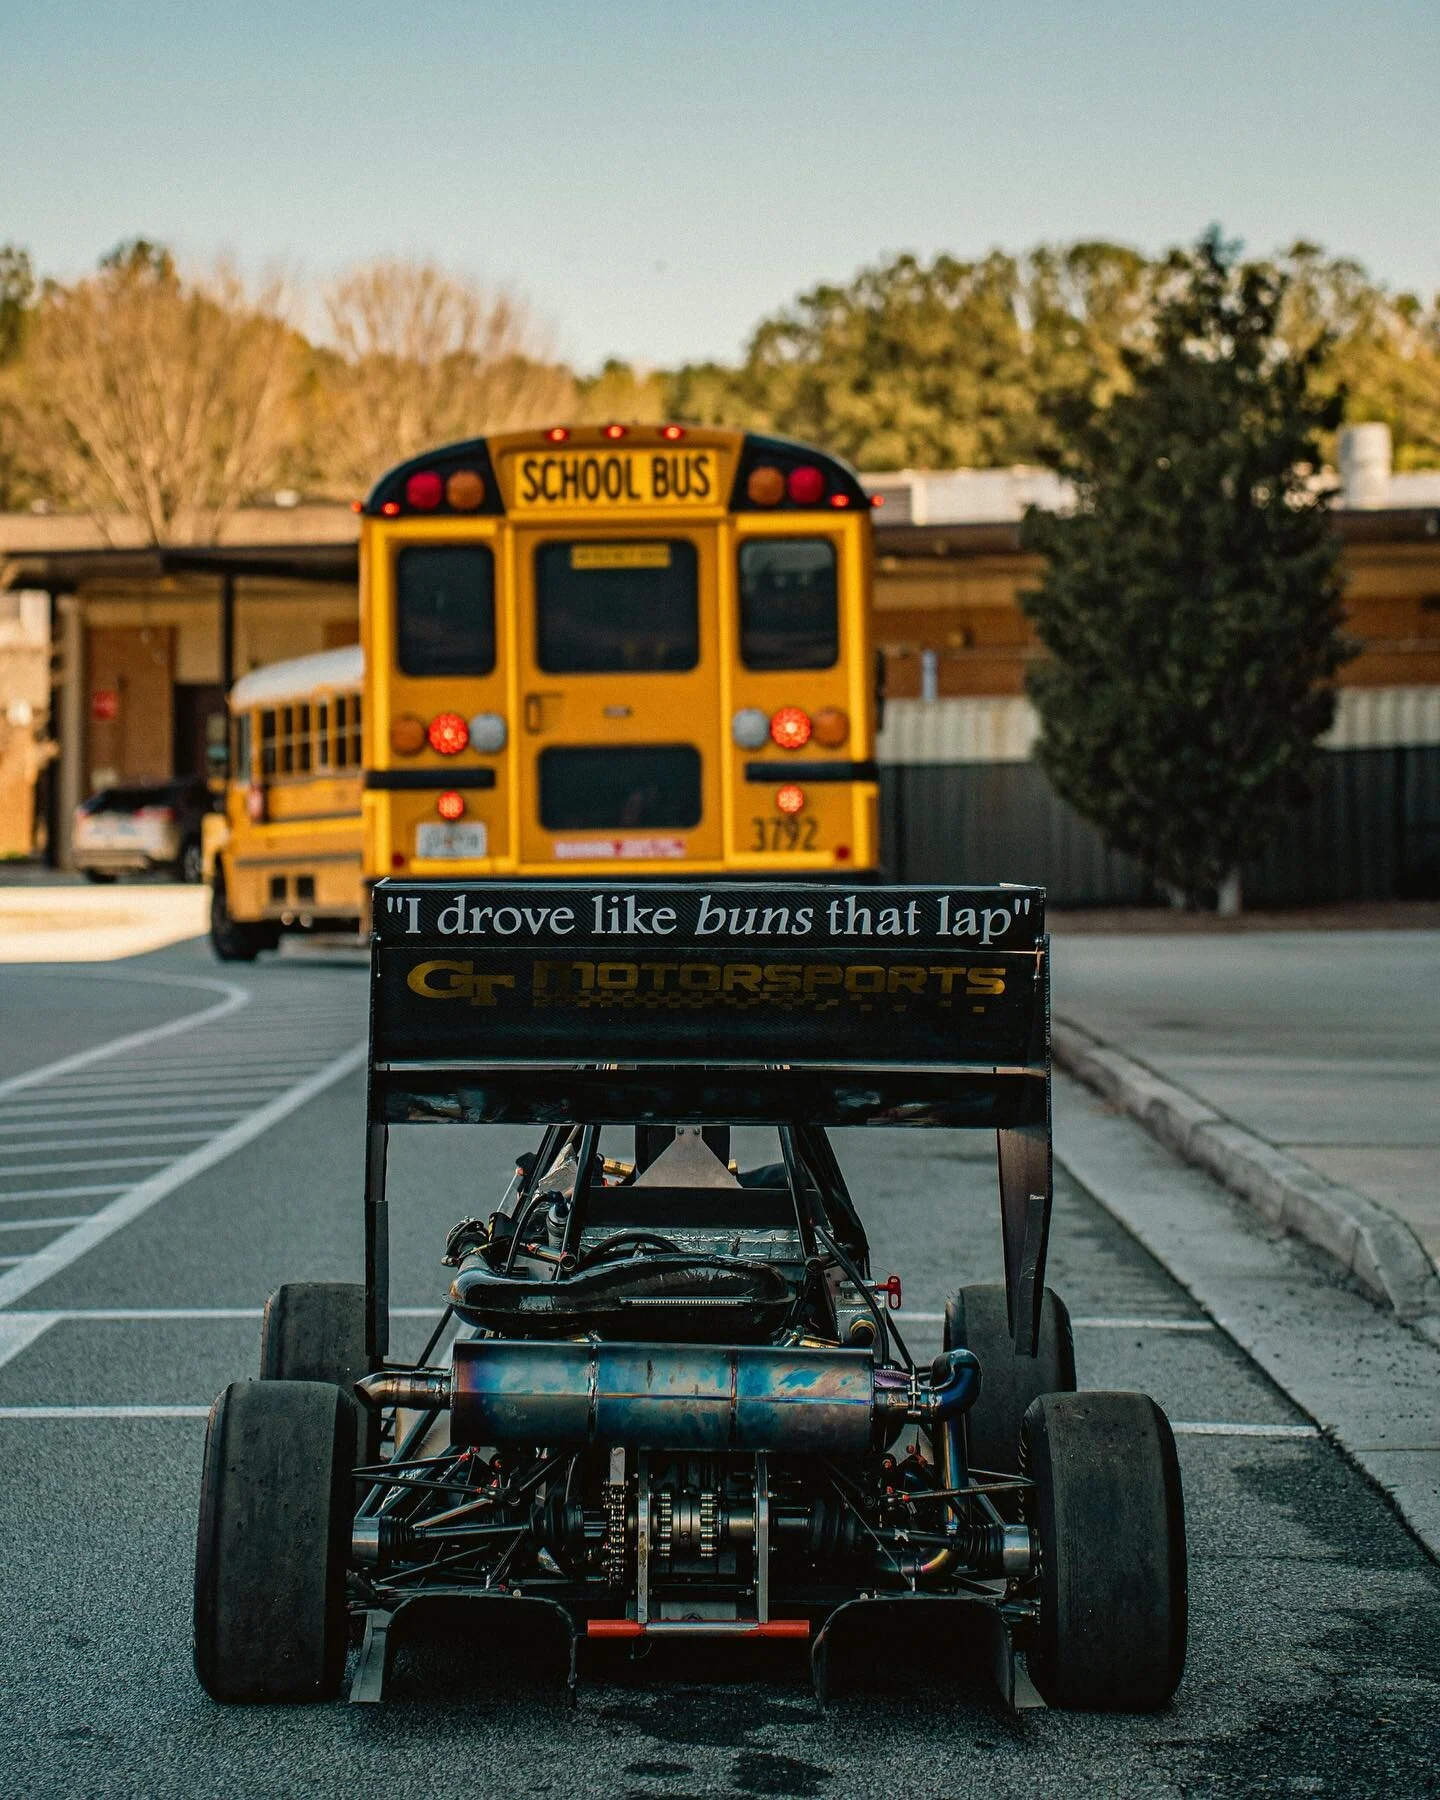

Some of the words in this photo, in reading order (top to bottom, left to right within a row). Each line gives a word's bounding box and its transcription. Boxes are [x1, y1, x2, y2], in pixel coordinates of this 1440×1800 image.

[522, 457, 641, 502] SCHOOL
[652, 456, 711, 499] BUS
[752, 815, 819, 852] 3792
[386, 895, 422, 935] "I
[436, 894, 576, 936] drove
[590, 894, 678, 936] like
[693, 894, 815, 937] buns
[825, 895, 922, 936] that
[935, 895, 1031, 945] lap"
[406, 959, 516, 1007] GT
[531, 960, 1007, 996] MOTORSPORTS
